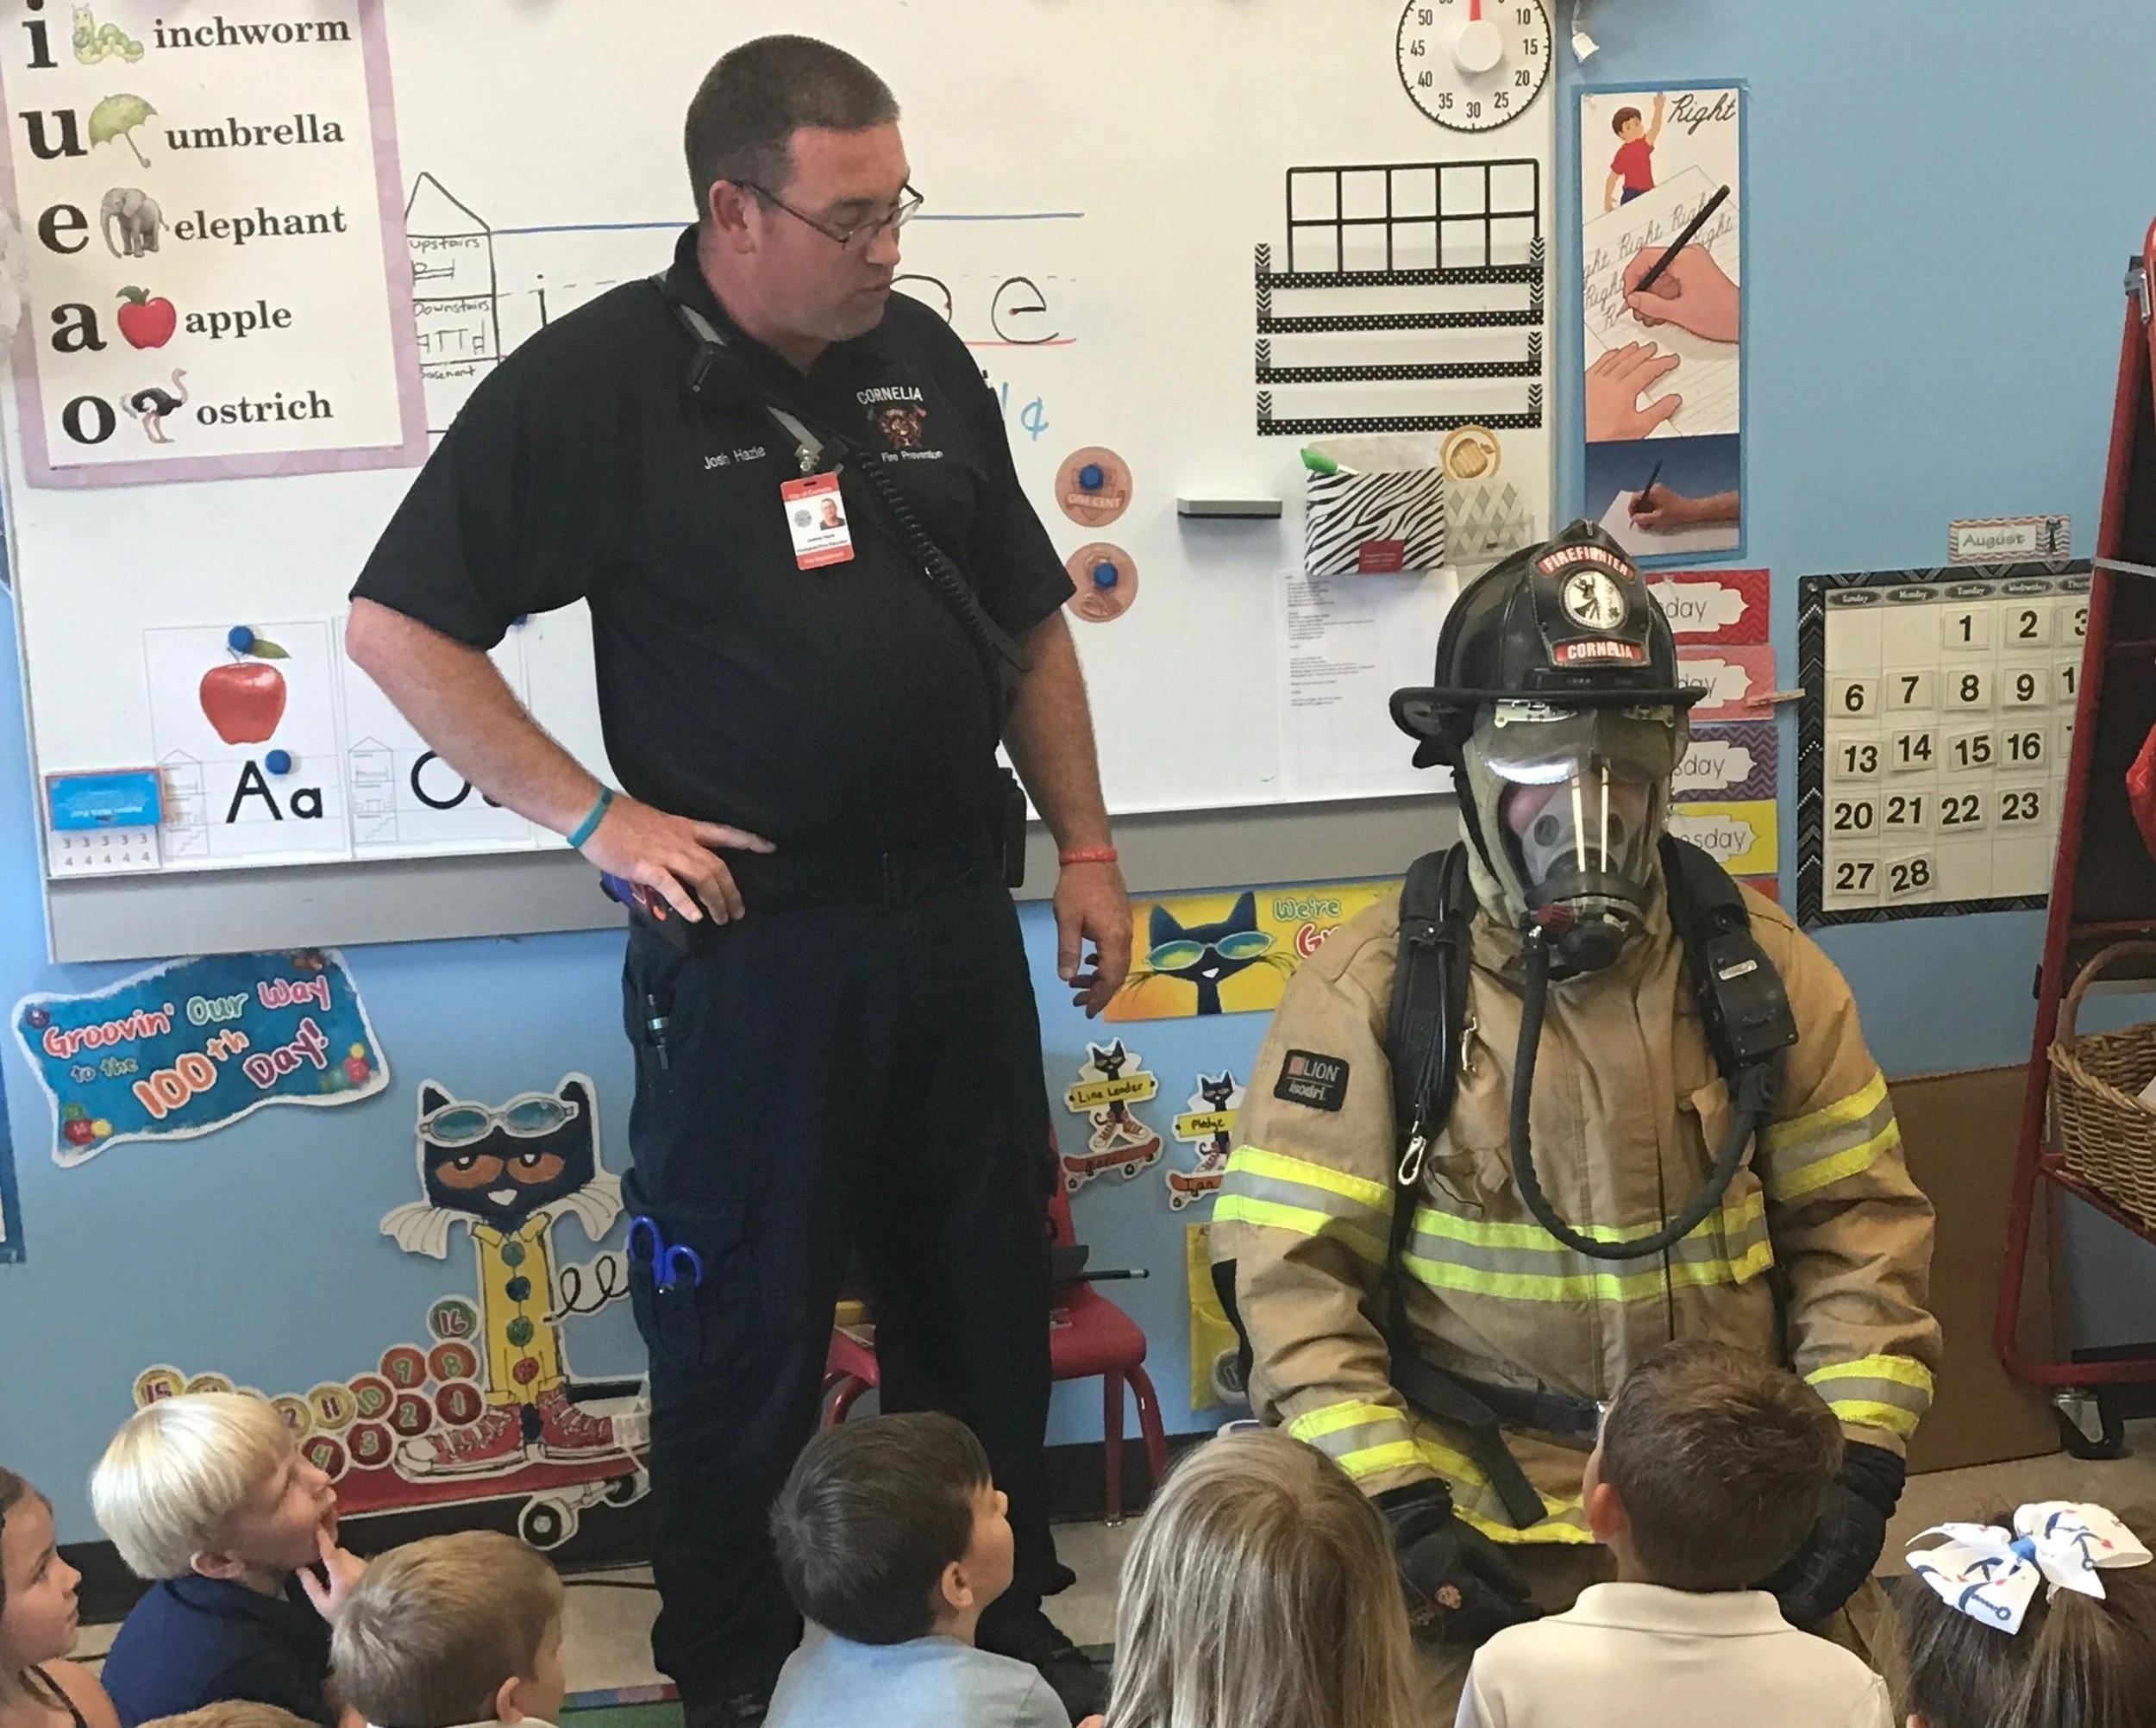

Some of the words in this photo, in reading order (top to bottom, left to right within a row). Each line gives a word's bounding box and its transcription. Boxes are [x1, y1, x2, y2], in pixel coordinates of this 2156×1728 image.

[1418, 9, 1432, 25] 50
[1516, 9, 1531, 25] 10
[22, 0, 58, 69] i
[154, 16, 352, 49] inchworm
[1523, 39, 1538, 55] 15
[1410, 40, 1426, 56] 45
[1418, 71, 1432, 87] 40
[1514, 70, 1530, 86] 20
[1438, 92, 1453, 110] 35
[1466, 102, 1481, 118] 30
[1494, 91, 1509, 109] 25
[1668, 92, 1736, 135] Right
[18, 108, 90, 160] u
[164, 114, 345, 150] umbrella
[1670, 192, 1713, 232] Righ
[37, 201, 91, 254] e
[173, 206, 348, 252] elephant
[992, 277, 1059, 344] e
[50, 301, 108, 354] a
[185, 301, 292, 340] apple
[856, 386, 924, 405] CORNELIA
[62, 395, 117, 445] o
[196, 391, 335, 425] ostrich
[705, 453, 730, 470] Josh
[881, 452, 899, 462] Fire
[900, 450, 943, 460] Prevention
[1092, 497, 1120, 508] CENT
[1963, 533, 2026, 549] August
[1543, 546, 1628, 576] FIREFIGHTER
[1664, 597, 1708, 623] day
[1959, 615, 1971, 642] 1
[2019, 611, 2038, 638] 2
[2074, 608, 2088, 636] 3
[1567, 642, 1633, 659] CORNELIA
[1677, 673, 1718, 698] day
[1845, 685, 1865, 711] 6
[1901, 677, 1919, 703] 7
[1960, 675, 1980, 702] 8
[2016, 673, 2035, 700] 9
[2062, 667, 2076, 694] 1
[1844, 746, 1878, 773] 13
[1898, 735, 1932, 762] 14
[1955, 736, 1991, 766] 15
[2007, 732, 2041, 760] 16
[1675, 755, 1726, 779] sday
[1833, 802, 1874, 830] 20
[1886, 796, 1922, 823] 21
[1941, 794, 1981, 825] 22
[2002, 793, 2040, 820] 23
[1683, 826, 1746, 850] sday
[1835, 863, 1874, 890] 27
[1890, 859, 1930, 892] 28
[1275, 897, 1342, 922] We're
[42, 1003, 175, 1059] Groovin'
[186, 992, 249, 1026] Our
[258, 975, 331, 1011] Way
[70, 1064, 96, 1083] to
[100, 1056, 139, 1077] the
[242, 1017, 329, 1089] Day!
[1303, 1060, 1341, 1082] LION
[1078, 1090, 1104, 1104] Line
[1107, 1083, 1143, 1098] Leader
[439, 1309, 468, 1335] 16
[392, 1357, 412, 1383] 9
[442, 1352, 463, 1378] 8
[321, 1396, 342, 1420] 11
[355, 1387, 385, 1415] 10
[452, 1391, 466, 1416] 1
[283, 1407, 299, 1430] 2
[399, 1402, 417, 1428] 2
[360, 1431, 379, 1456] 3
[311, 1444, 333, 1470] 4
